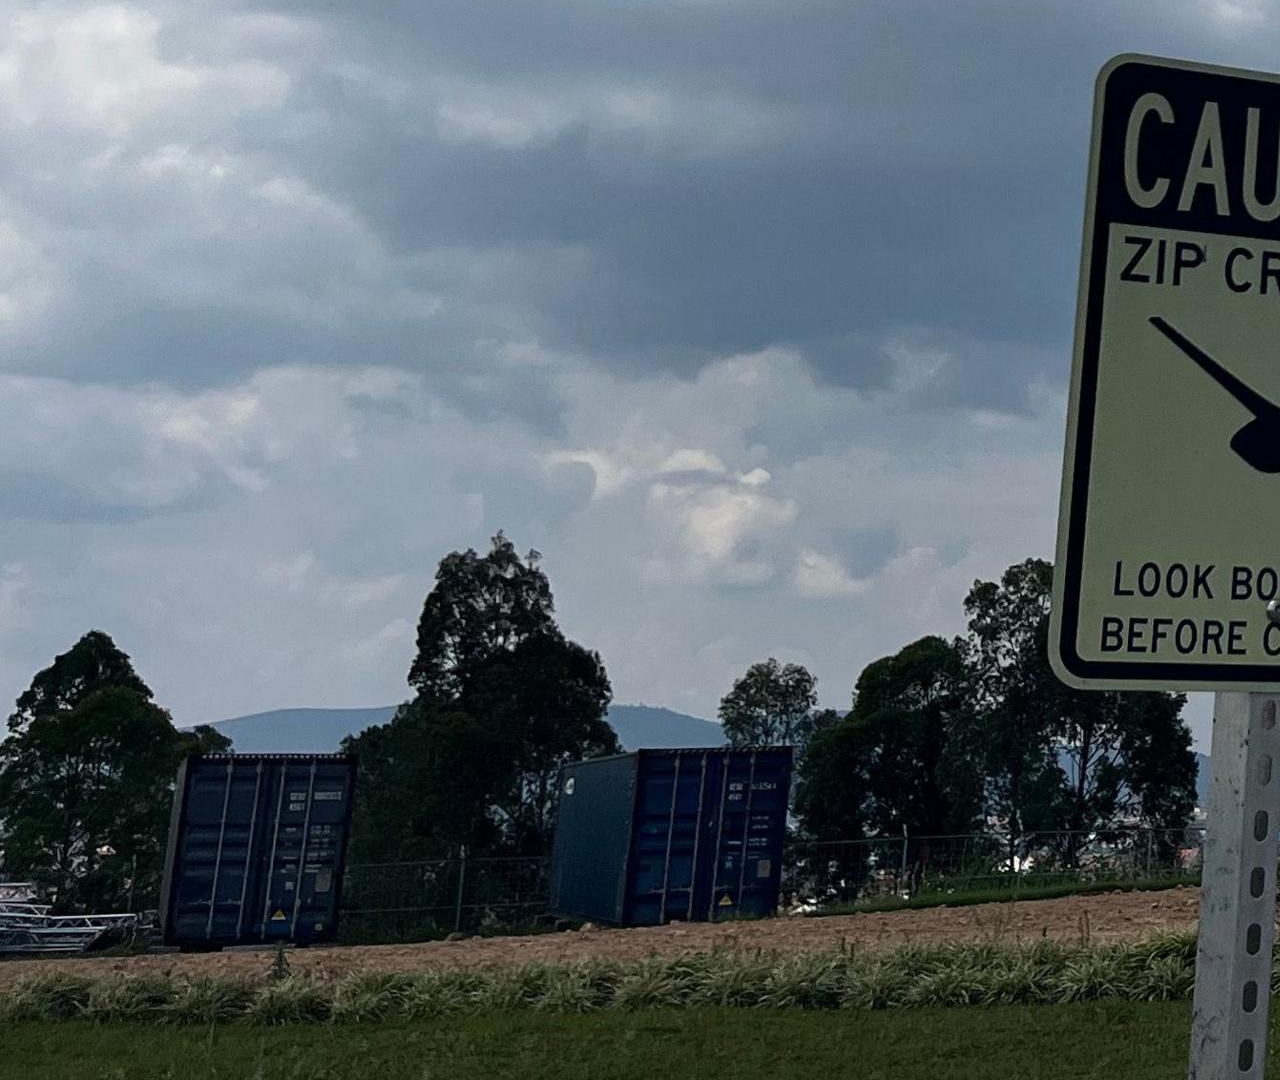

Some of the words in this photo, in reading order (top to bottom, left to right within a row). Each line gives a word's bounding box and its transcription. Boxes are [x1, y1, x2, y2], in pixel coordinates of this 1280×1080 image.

[1120, 236, 1204, 286] ZIP
[1113, 560, 1216, 600] LOOK
[1100, 616, 1248, 655] BEFORE
